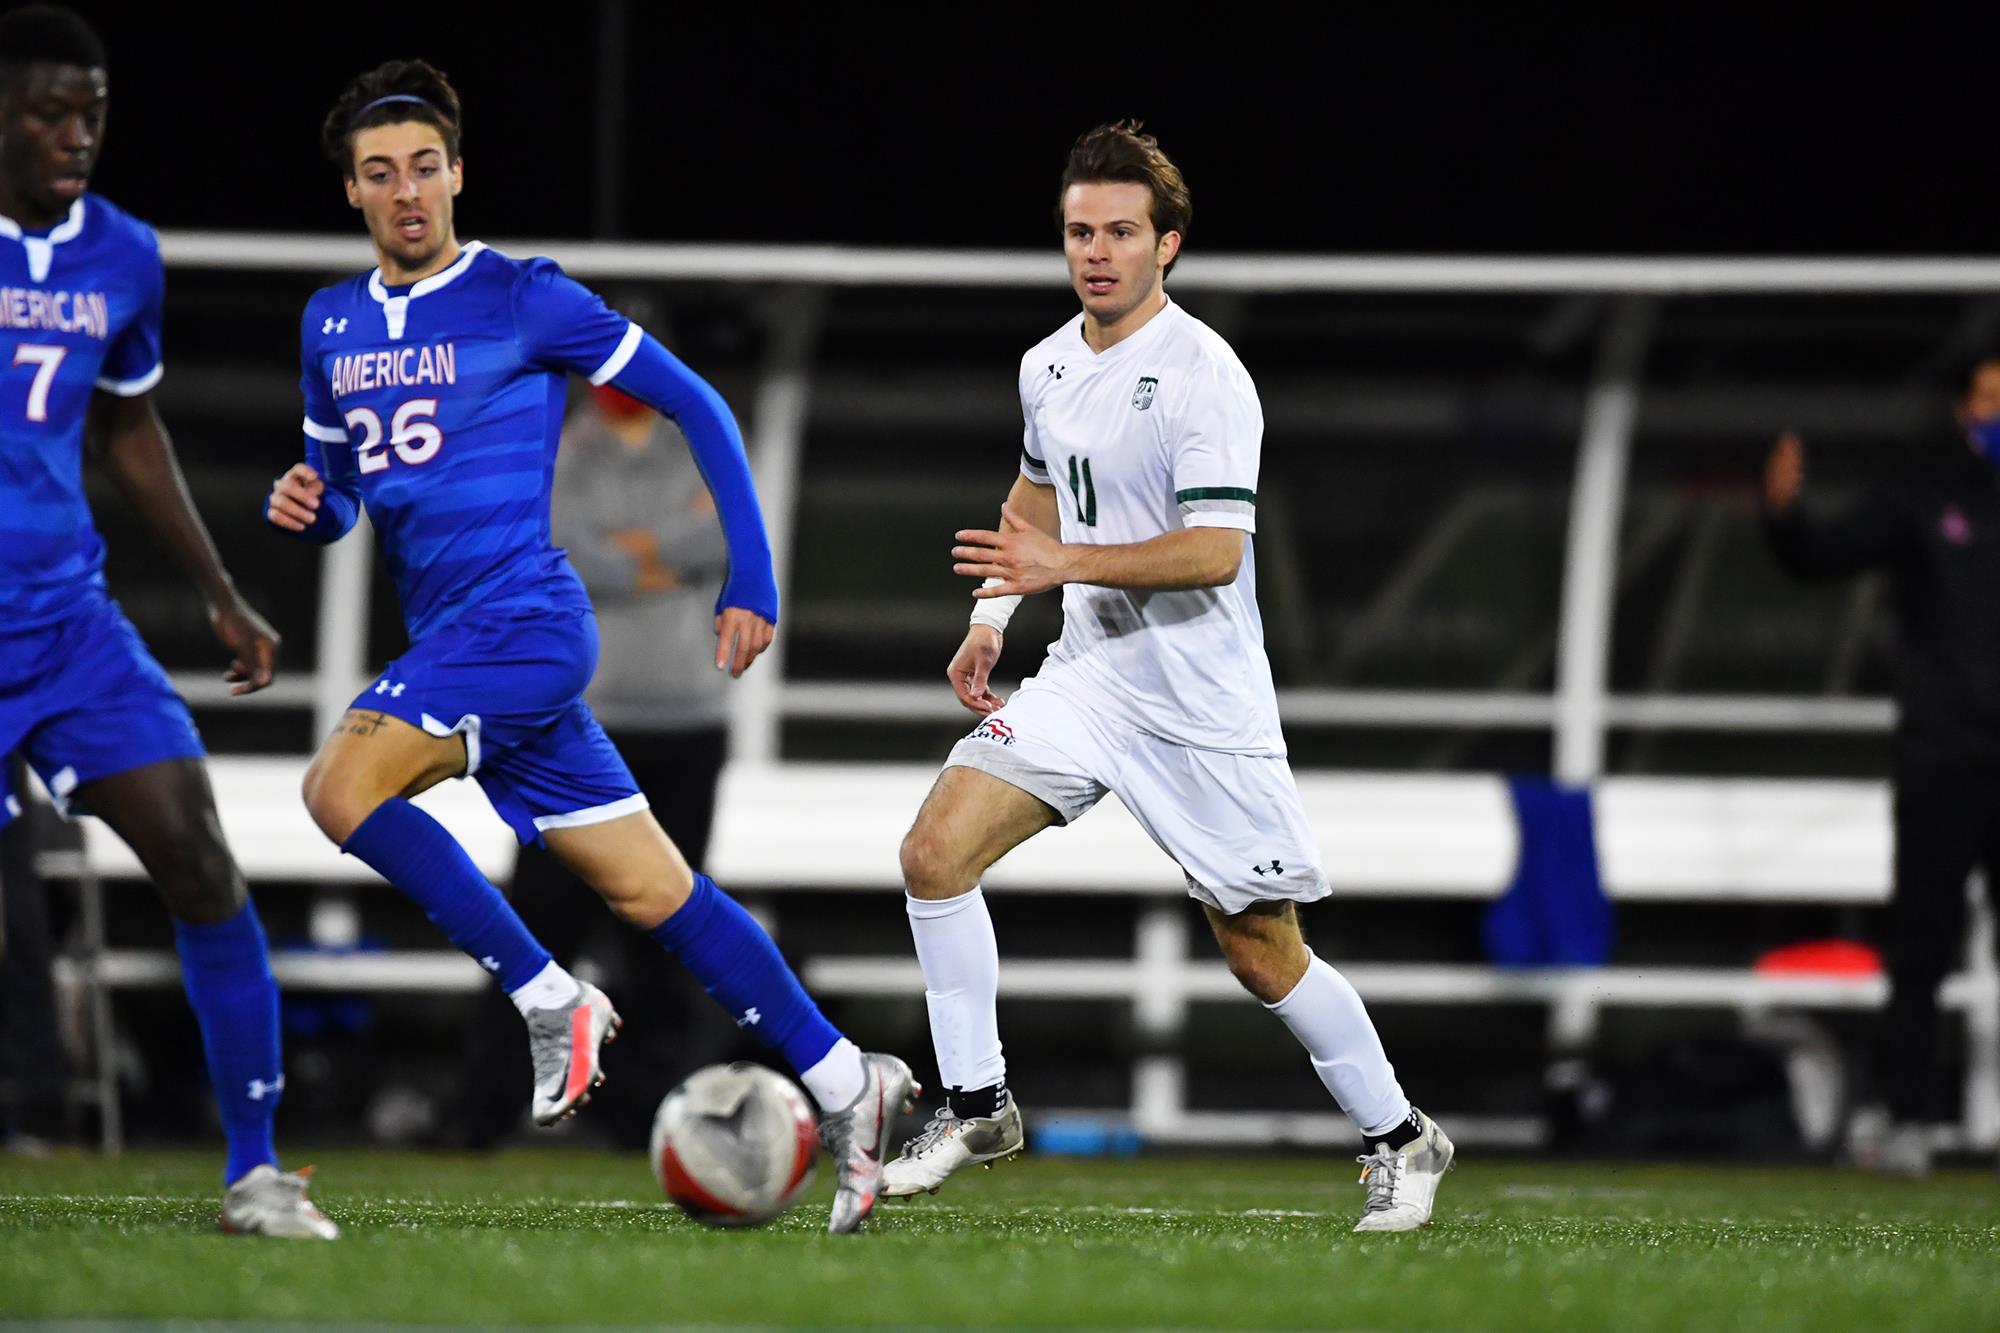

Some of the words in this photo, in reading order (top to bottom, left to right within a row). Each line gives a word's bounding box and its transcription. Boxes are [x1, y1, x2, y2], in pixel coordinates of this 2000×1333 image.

[12, 343, 69, 422] 7
[331, 342, 457, 399] AMERICAN
[345, 398, 444, 475] 26
[1068, 454, 1097, 527] 11
